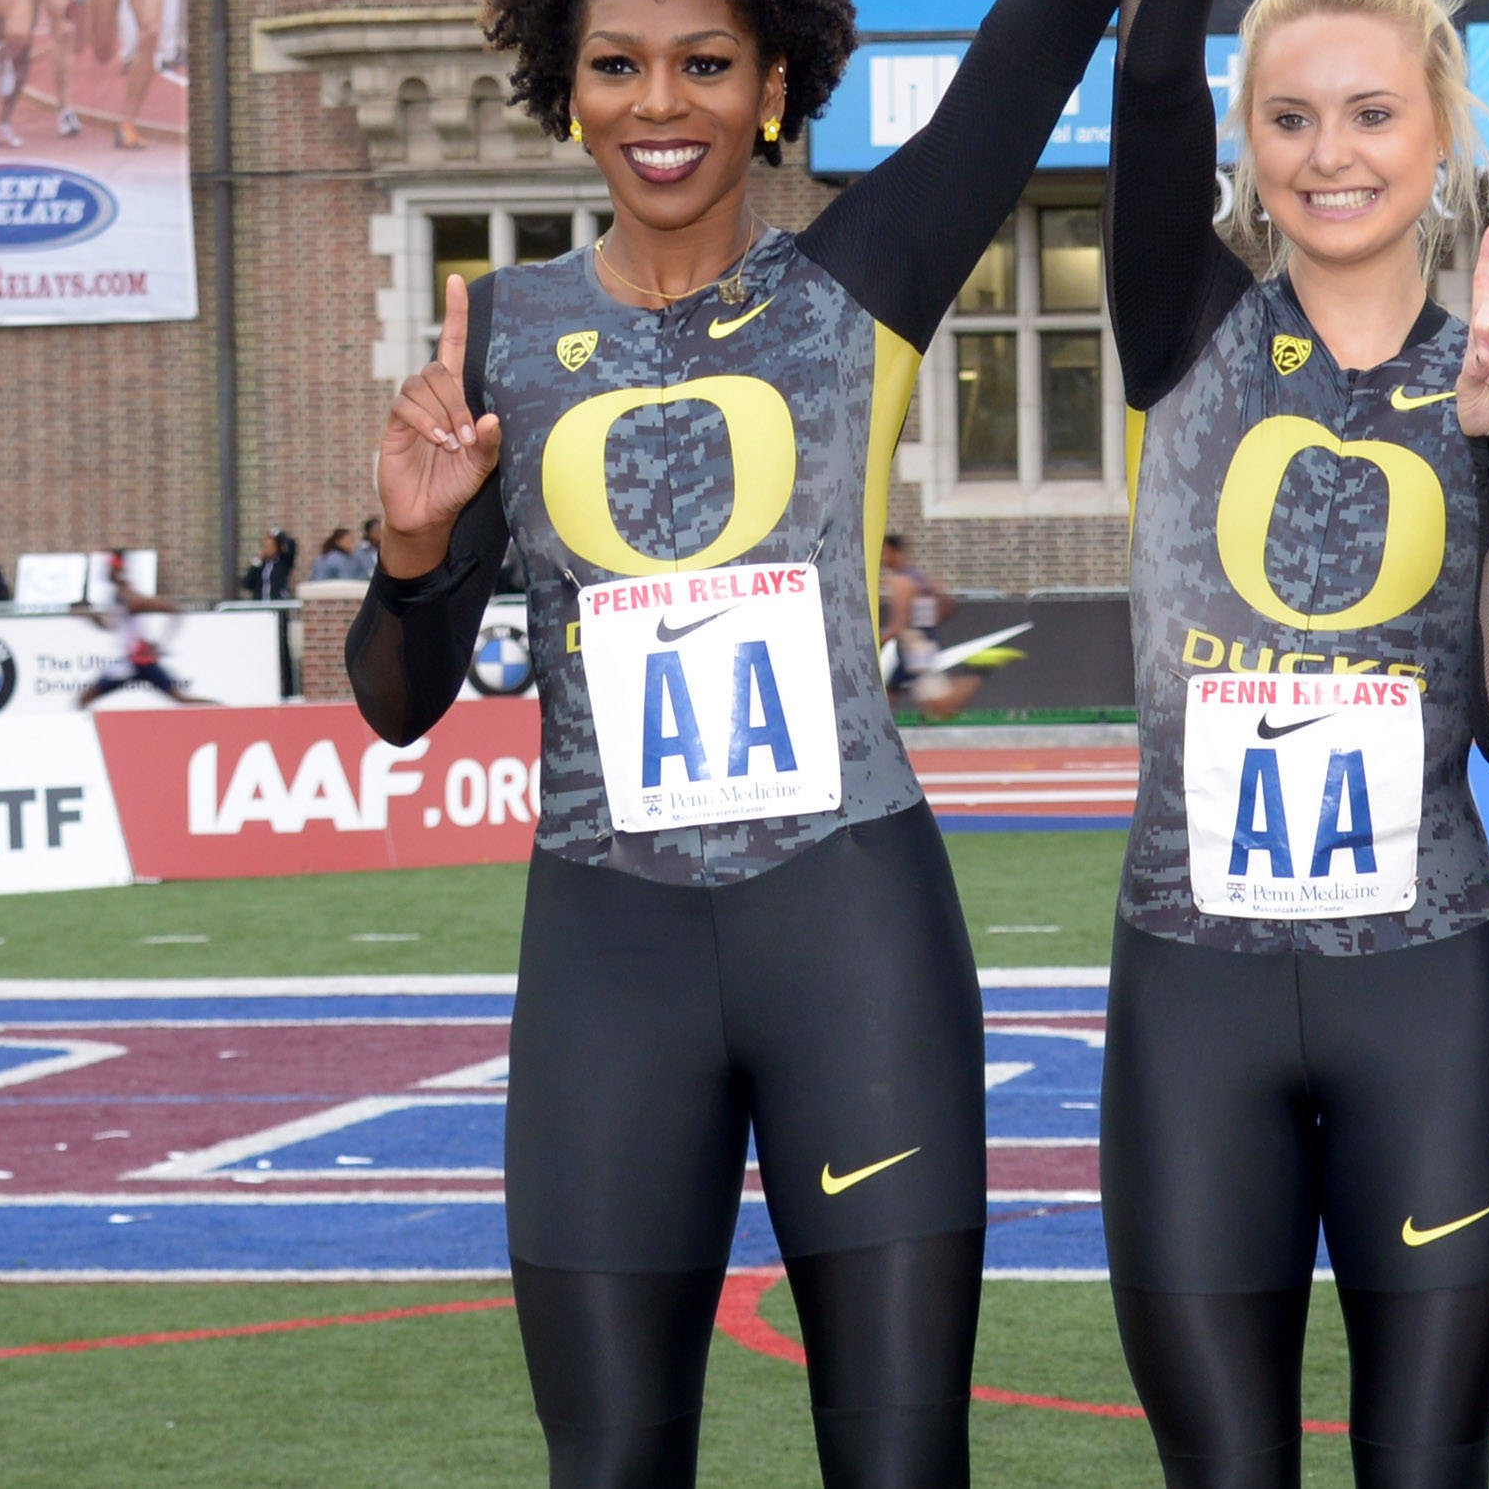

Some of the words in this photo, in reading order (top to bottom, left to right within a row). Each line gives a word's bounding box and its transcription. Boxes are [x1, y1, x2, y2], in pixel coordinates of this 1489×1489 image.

[593, 582, 673, 615] PENN
[689, 569, 805, 603] RELAYS
[1201, 680, 1277, 704] PENN
[1293, 681, 1407, 707] RELAYS
[641, 640, 799, 788] AA
[670, 792, 715, 810] Penn
[720, 782, 801, 803] Medicine
[1228, 748, 1378, 878] AA
[1253, 884, 1295, 901] Penn
[1300, 882, 1380, 901] Medicine
